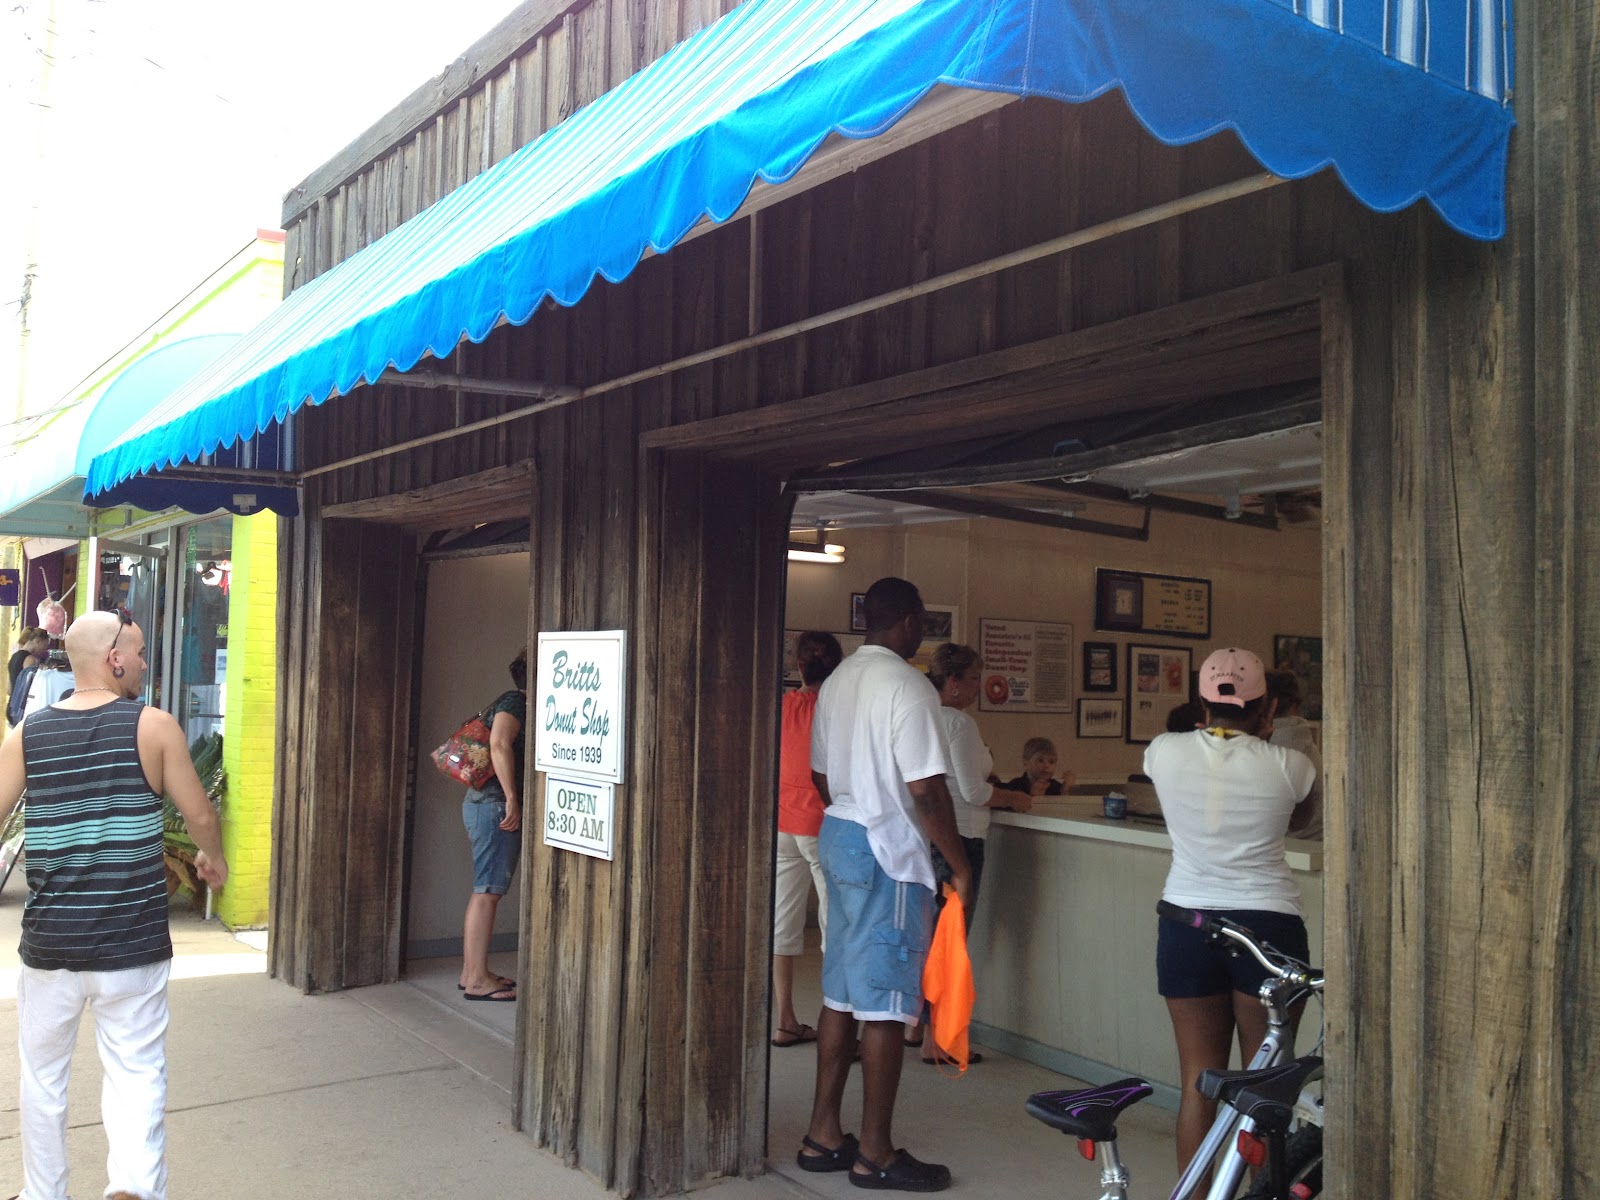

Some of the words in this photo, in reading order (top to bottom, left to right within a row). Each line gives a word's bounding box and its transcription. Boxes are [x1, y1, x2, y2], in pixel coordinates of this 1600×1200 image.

[552, 650, 602, 692] Britts
[545, 695, 577, 735] Donut
[580, 697, 610, 746] Shop
[552, 743, 577, 762] Since
[579, 746, 602, 764] 1939
[557, 788, 597, 816] OPEN
[548, 811, 577, 835] 8:30
[579, 816, 604, 842] AM
